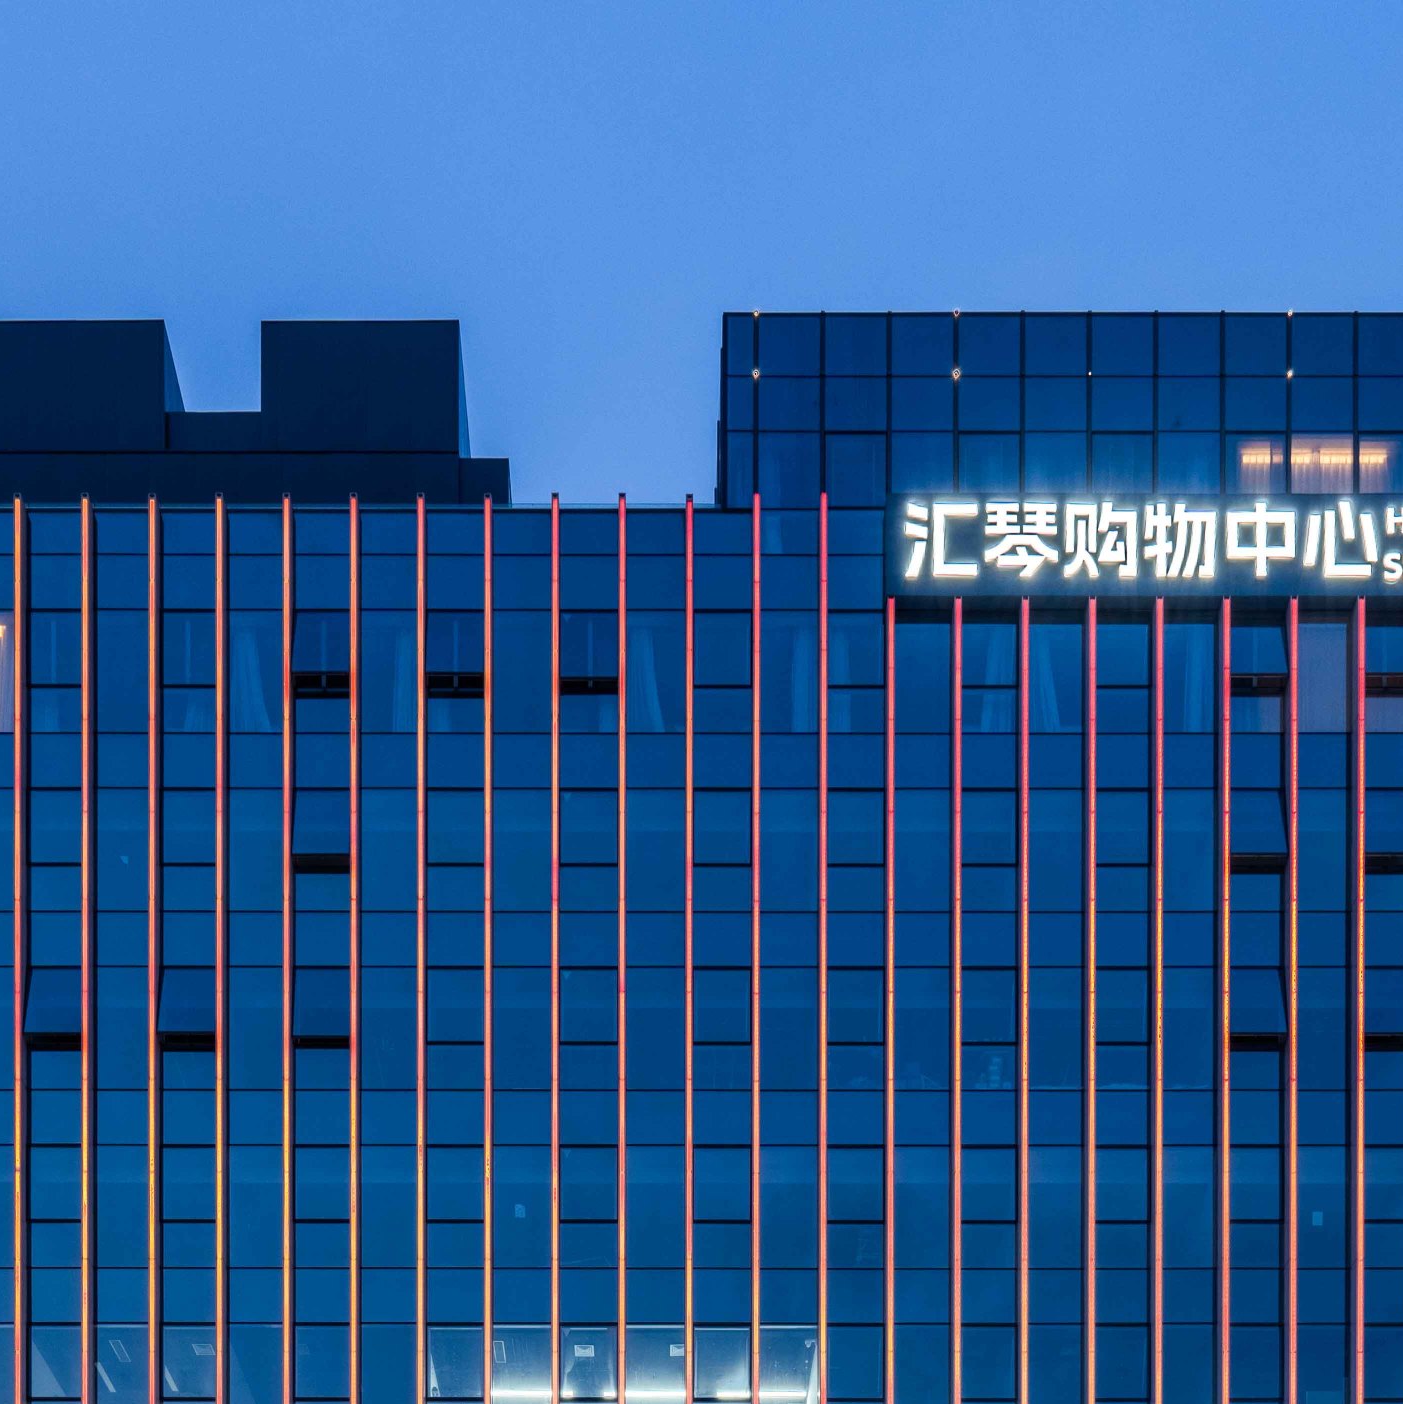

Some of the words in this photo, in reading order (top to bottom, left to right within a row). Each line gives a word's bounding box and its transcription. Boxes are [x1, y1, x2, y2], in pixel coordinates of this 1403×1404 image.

[903, 499, 1379, 581] 汇琴购物中心
